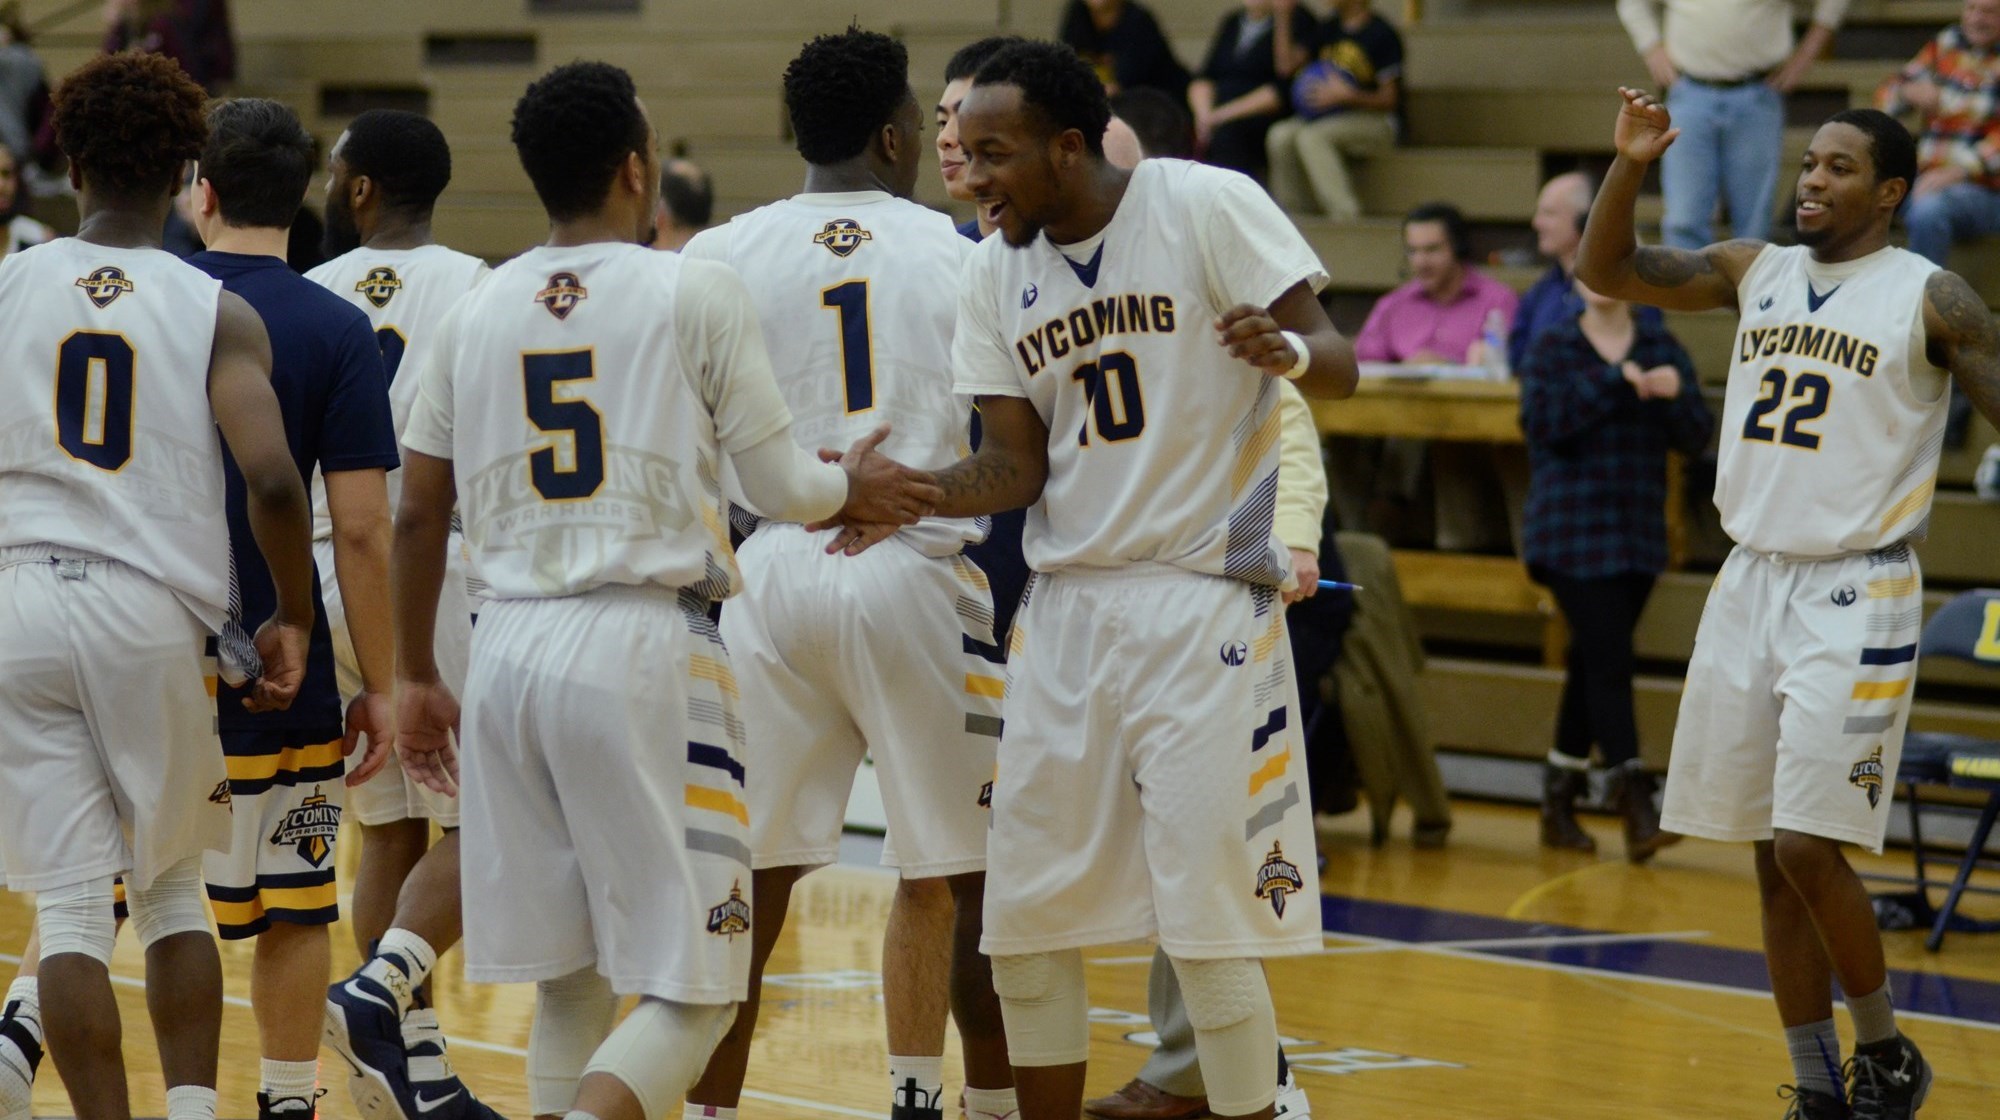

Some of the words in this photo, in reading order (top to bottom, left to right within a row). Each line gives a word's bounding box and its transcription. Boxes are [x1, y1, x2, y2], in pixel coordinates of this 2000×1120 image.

[820, 278, 876, 417] 1
[1016, 293, 1176, 379] LYCOMING
[1740, 322, 1880, 380] LYCOMING
[53, 328, 137, 475] 0
[520, 346, 604, 503] 5
[1072, 350, 1147, 448] 10
[1741, 366, 1833, 452] 22
[496, 501, 643, 532] WARRIORS
[276, 806, 340, 838] LYCOMIN
[284, 825, 338, 838] WARRIOR
